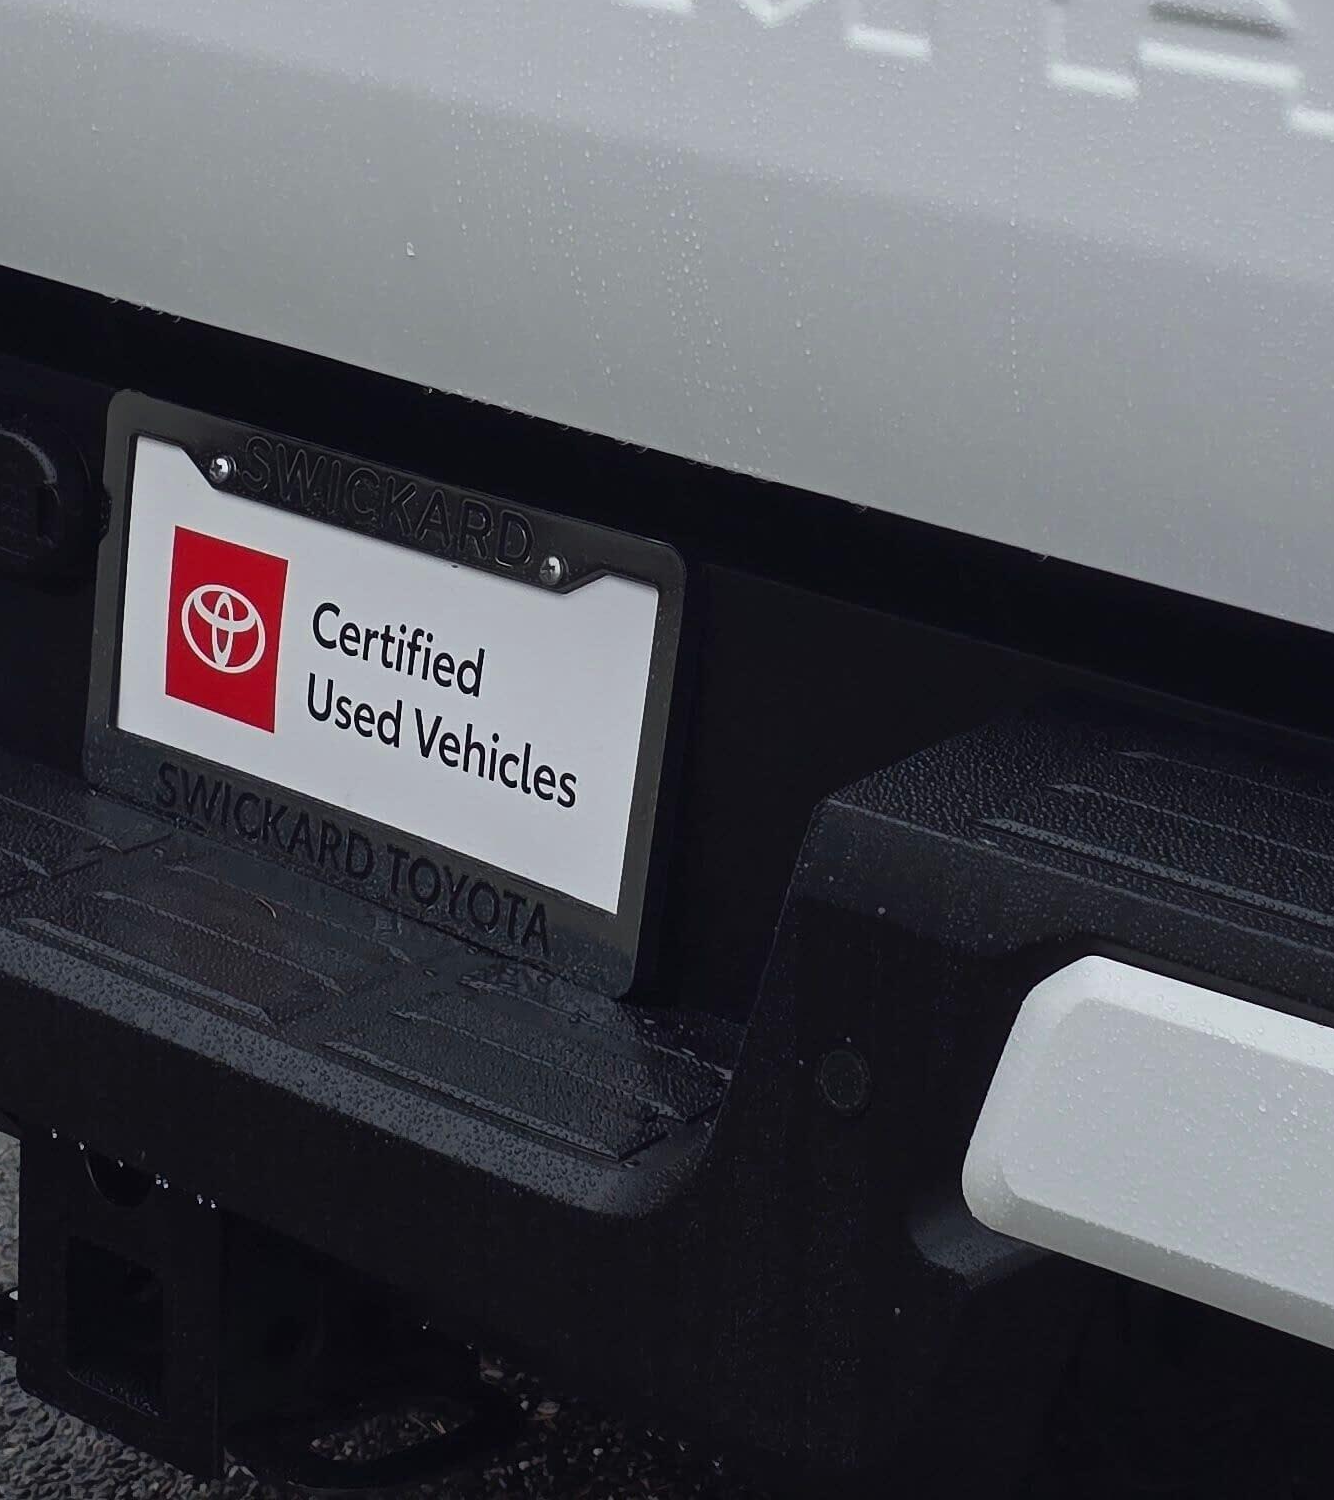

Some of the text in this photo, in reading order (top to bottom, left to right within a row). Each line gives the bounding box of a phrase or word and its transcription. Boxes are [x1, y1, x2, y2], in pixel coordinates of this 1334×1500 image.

[240, 434, 535, 570] SWICKARD
[310, 601, 486, 698] Certified
[305, 672, 579, 809] Used Vehicles
[156, 760, 550, 951] SWICKARD TOYOTA
